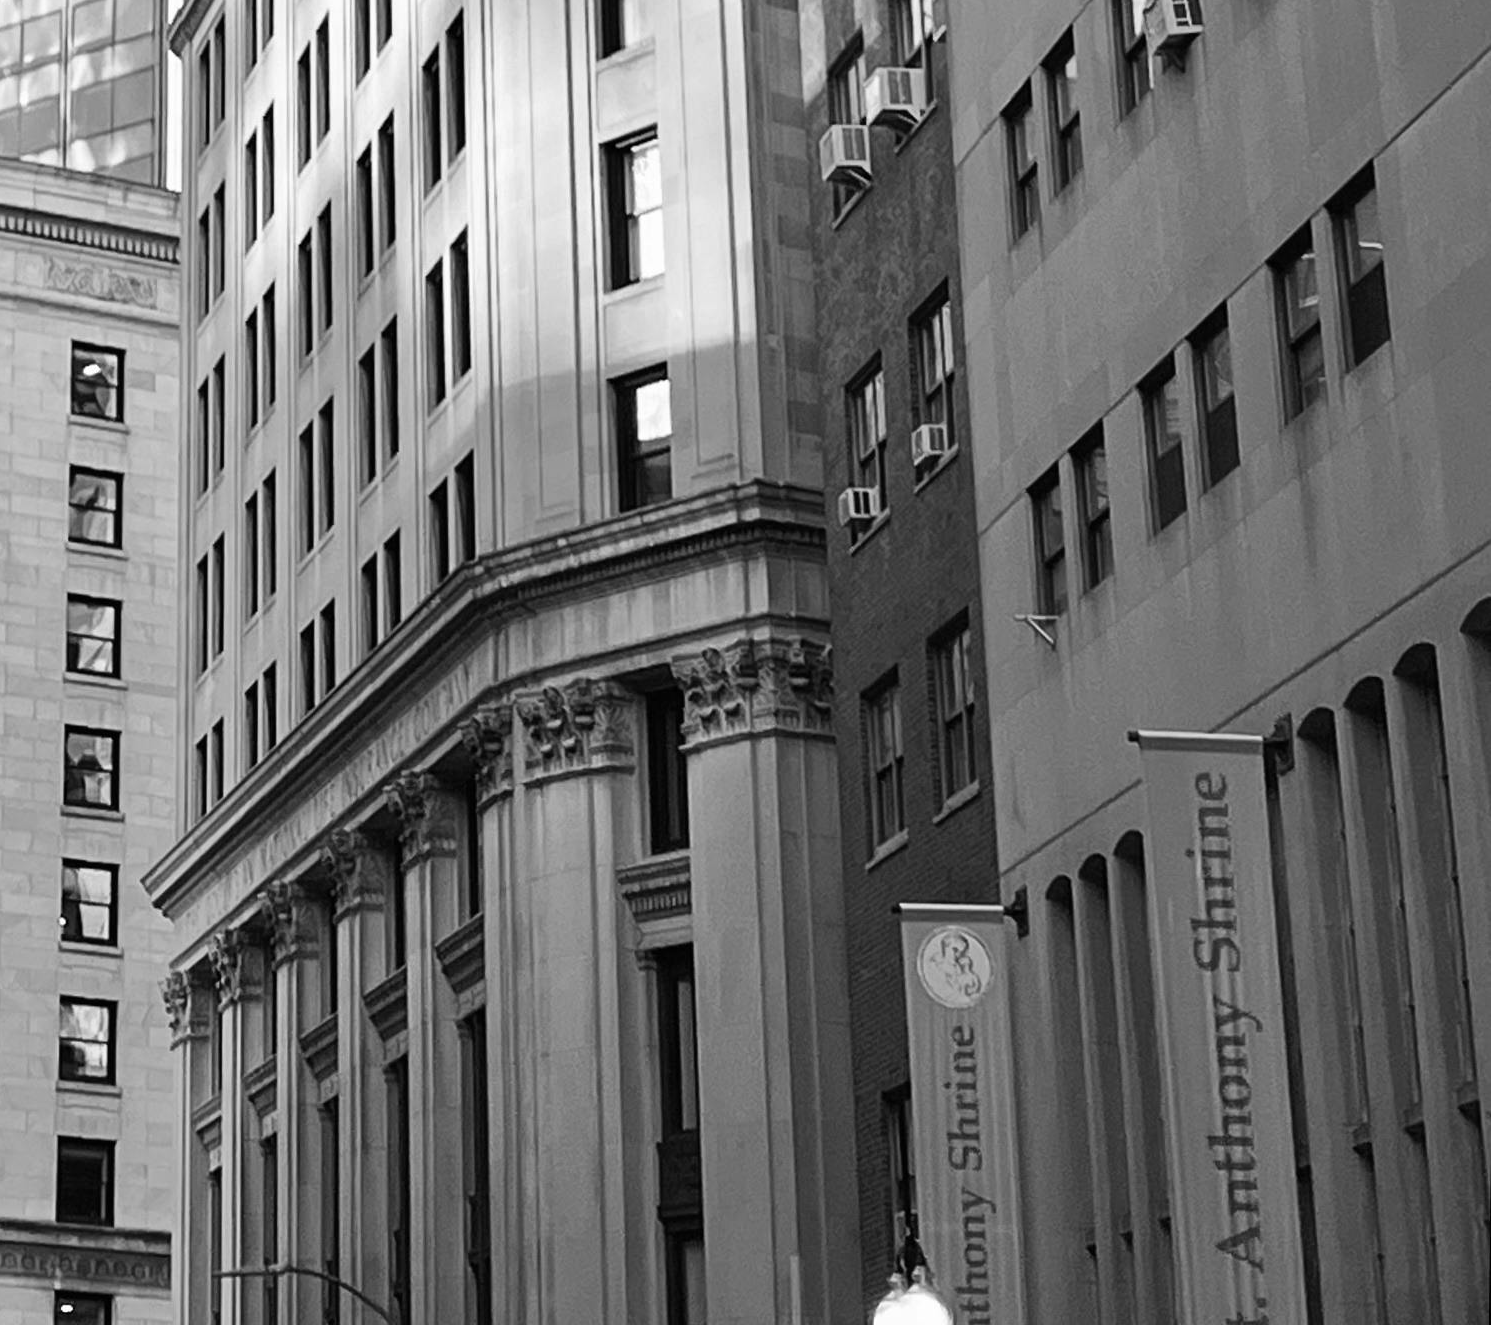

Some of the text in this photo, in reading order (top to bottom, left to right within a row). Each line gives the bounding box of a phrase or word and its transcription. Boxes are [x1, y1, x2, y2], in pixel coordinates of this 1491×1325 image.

[1185, 772, 1241, 972] Shrine
[943, 1024, 983, 1172] Shrine
[1206, 994, 1264, 1274] Anthony
